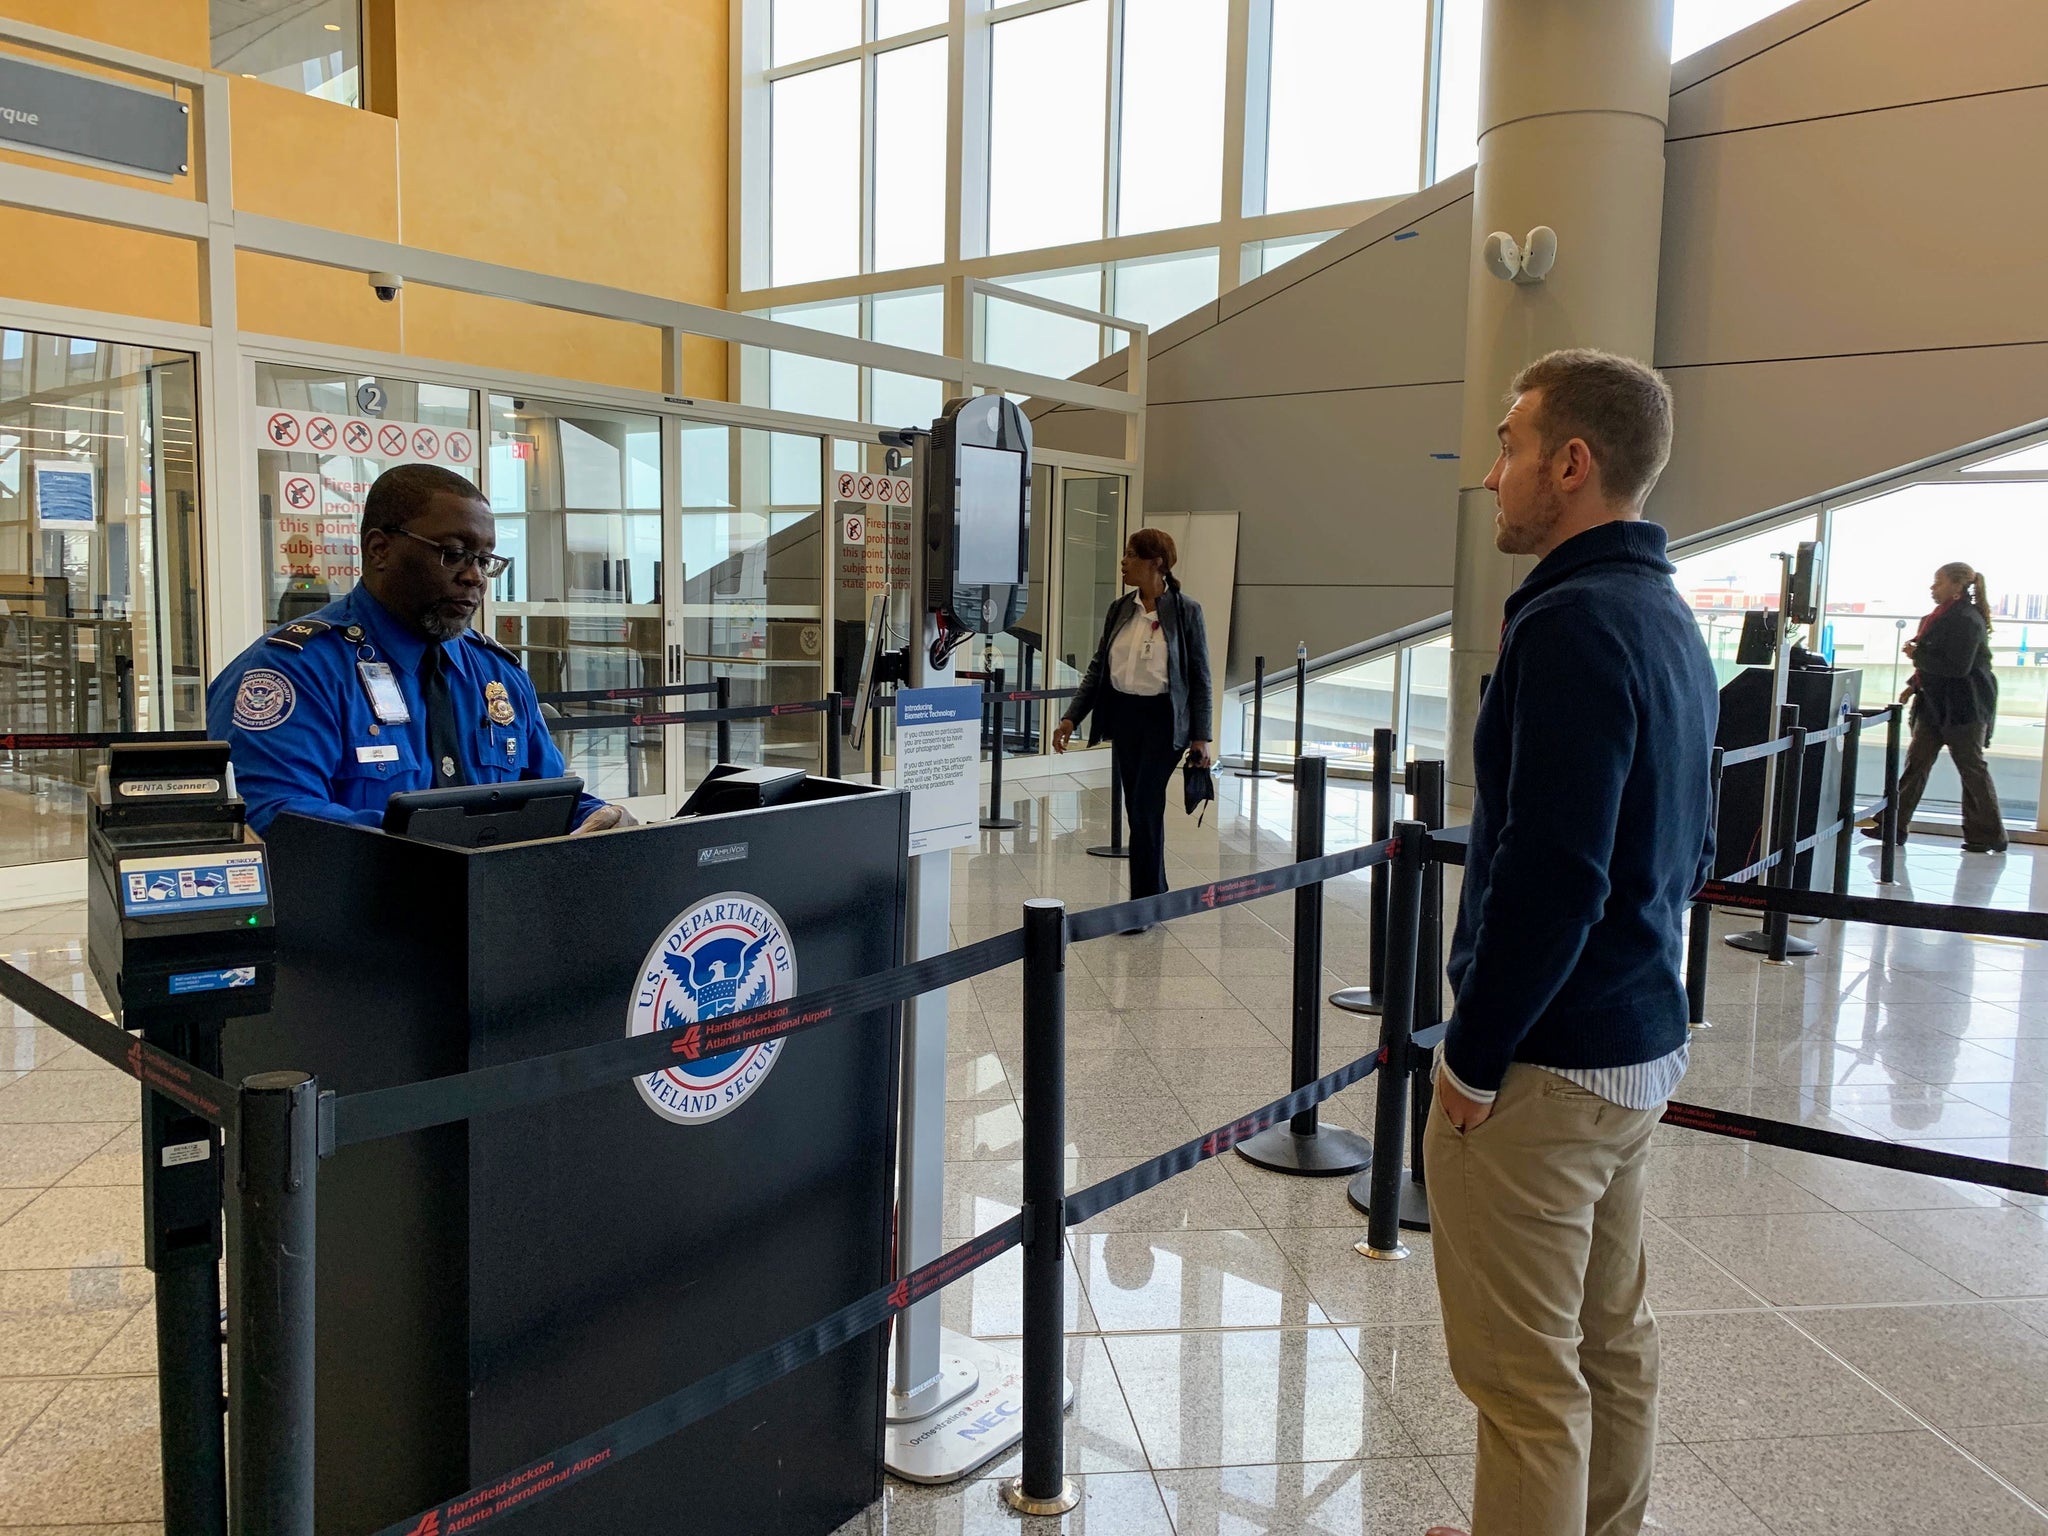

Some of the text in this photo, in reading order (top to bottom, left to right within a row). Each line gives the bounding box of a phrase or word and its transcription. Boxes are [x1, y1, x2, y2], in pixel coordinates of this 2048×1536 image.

[365, 388, 382, 411] 2
[891, 452, 899, 468] 1
[324, 477, 371, 492] Firear
[324, 499, 365, 515] prohi
[279, 519, 308, 532] this
[903, 522, 911, 531] ar
[280, 540, 360, 557] subject to
[843, 547, 858, 558] this
[889, 551, 911, 561] Violat
[281, 560, 361, 580] state pros
[842, 562, 911, 576] subject to federa
[842, 580, 864, 590] state
[286, 624, 313, 635] TSA
[242, 671, 277, 683] ORTATION
[275, 677, 291, 703] SECURITY
[904, 703, 933, 712] Introducing
[904, 709, 957, 720] Biometric Technology
[909, 732, 918, 740] you
[918, 730, 934, 738] choose
[904, 747, 915, 755] your
[916, 743, 941, 753] photograph
[904, 769, 919, 778] please
[919, 767, 932, 775] notify
[908, 762, 918, 770] you
[130, 782, 207, 792] PENTA Scanner
[638, 903, 790, 1008] U.S. DEPARTMENT OF
[705, 1006, 789, 1035] Hartsfield-Jackson
[705, 1008, 832, 1050] Atlanta International Airport
[646, 1041, 777, 1113] MELAND SECUR
[909, 1407, 967, 1445] Orchestrating
[956, 1400, 1022, 1441] NEC
[446, 1460, 555, 1517] Hartsfield-Jackson
[446, 1448, 612, 1535] Atlanta International Airport
